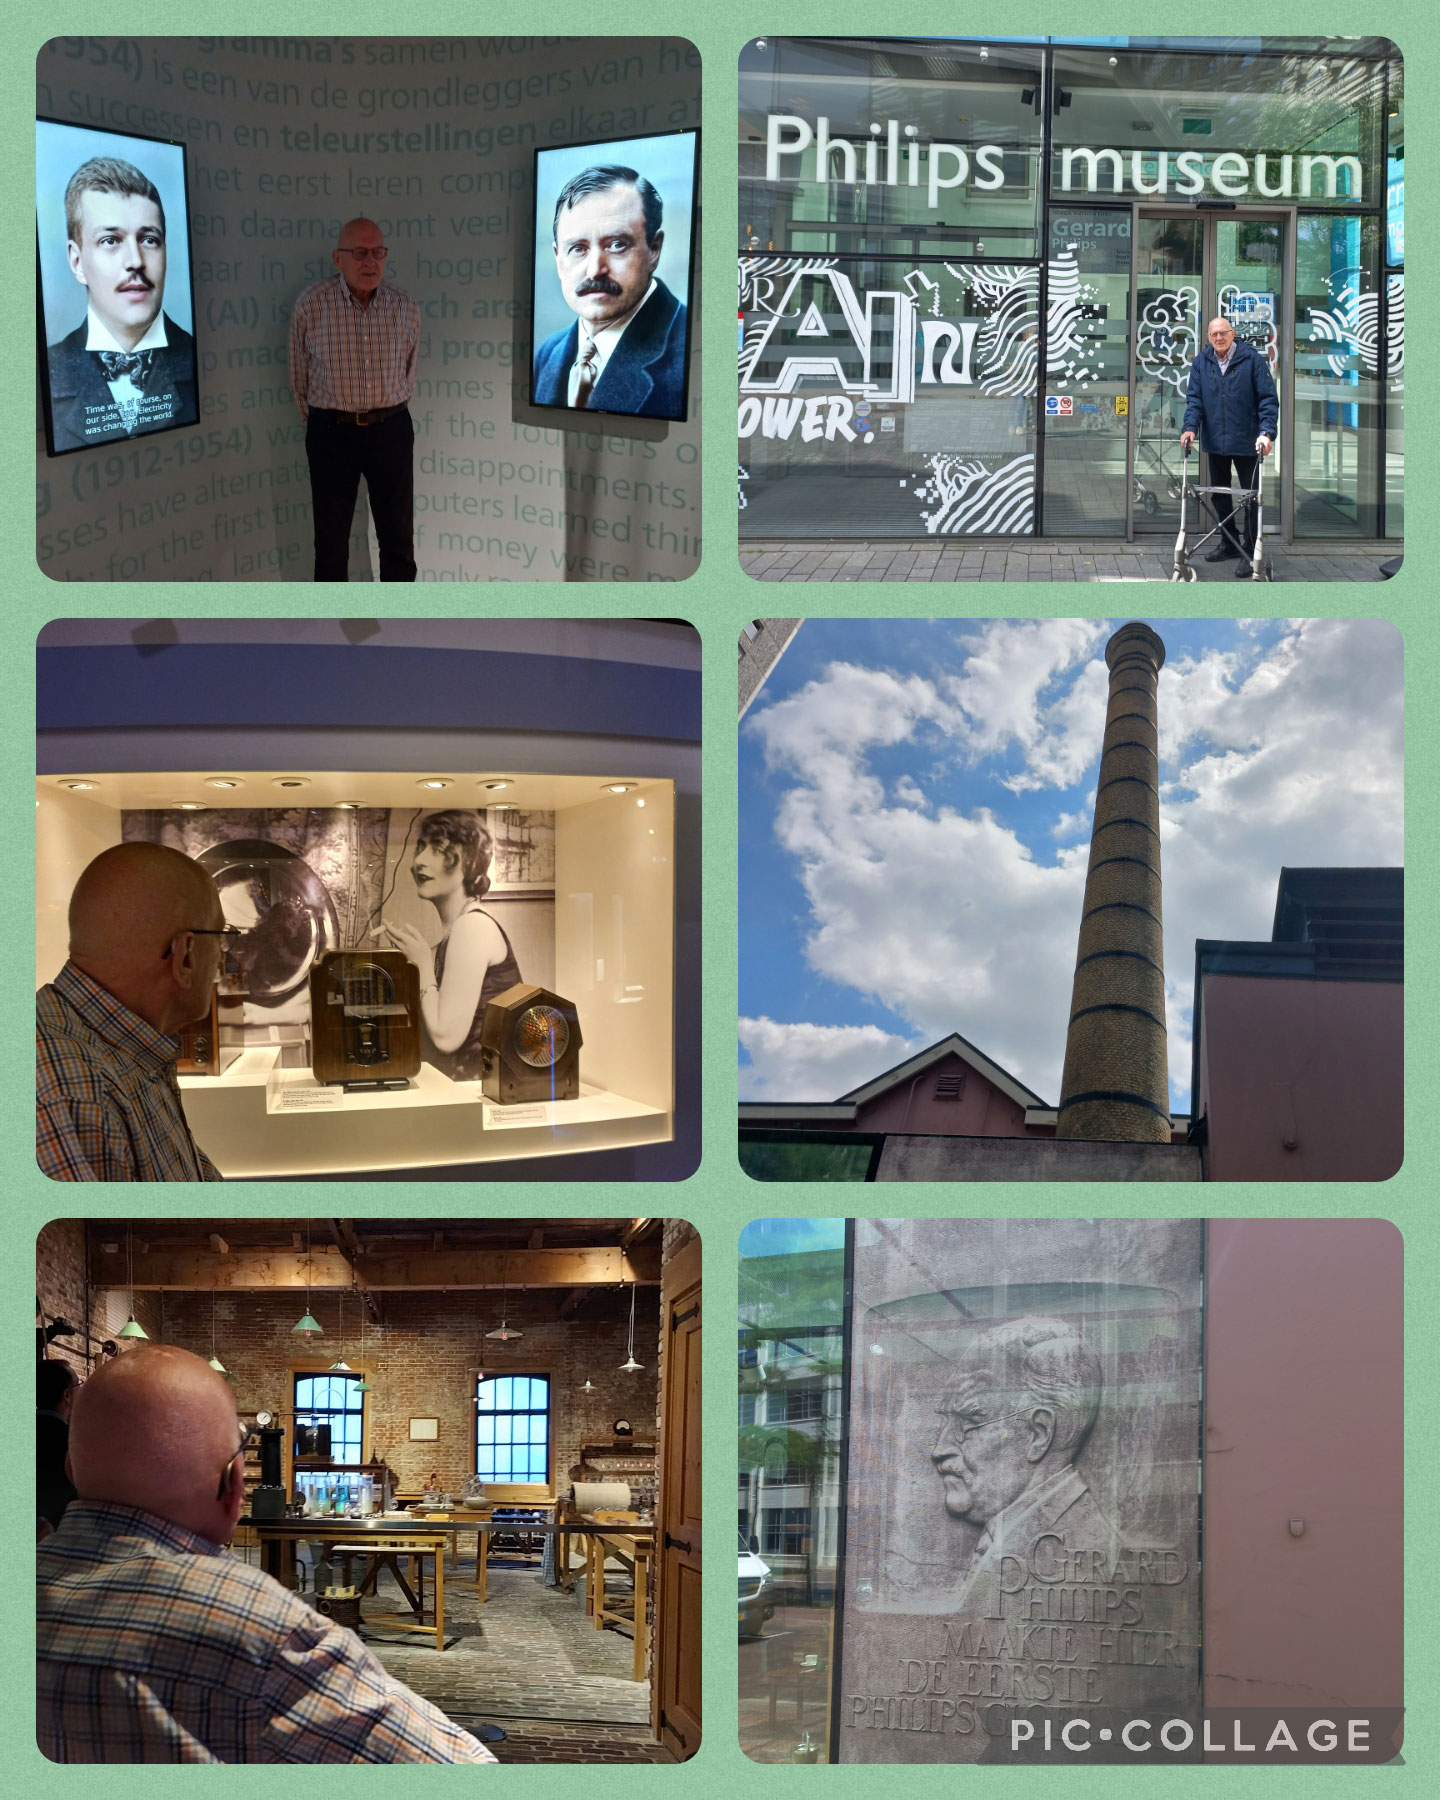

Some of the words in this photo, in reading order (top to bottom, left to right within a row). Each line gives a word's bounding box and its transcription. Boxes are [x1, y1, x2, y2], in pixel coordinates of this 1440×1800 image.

[364, 39, 467, 65] samen
[153, 49, 173, 85] is
[182, 66, 237, 98] een
[247, 79, 300, 107] van
[311, 77, 348, 109] de
[358, 68, 572, 118] grondleggers
[582, 55, 644, 87] van
[68, 90, 222, 144] successen
[233, 124, 269, 148] en
[280, 121, 536, 156] teleurstellingen
[549, 103, 655, 140] elkaar
[194, 155, 243, 193] het
[258, 171, 332, 196] eerst
[348, 168, 422, 197] leren
[440, 168, 535, 199] comp
[766, 114, 1005, 208] Philips
[1062, 148, 1362, 199] museum
[450, 205, 511, 237] veel
[1052, 217, 1131, 238] Gerard
[261, 254, 286, 281] in
[415, 251, 508, 286] hoger
[85, 405, 106, 415] Time
[85, 426, 101, 435] was
[103, 418, 138, 432] changing
[139, 415, 152, 424] the
[86, 416, 99, 425] our
[138, 402, 173, 415] Electricity
[71, 424, 253, 501] (1912-1954)
[447, 411, 497, 439] the
[511, 414, 657, 460] founders
[118, 491, 187, 533] have
[419, 449, 696, 511] disappointments.
[159, 528, 205, 563] the
[211, 506, 264, 543] first
[513, 494, 632, 544] learned
[233, 541, 301, 577] large
[438, 531, 538, 569] money
[550, 549, 631, 582] were
[1028, 1532, 1188, 1584] GERARD
[985, 1554, 1144, 1627] PHILIPS
[939, 1621, 1077, 1663] MAAKTE
[1090, 1627, 1186, 1668] HIER
[898, 1658, 948, 1695] DE
[956, 1660, 1102, 1703] EERSTE
